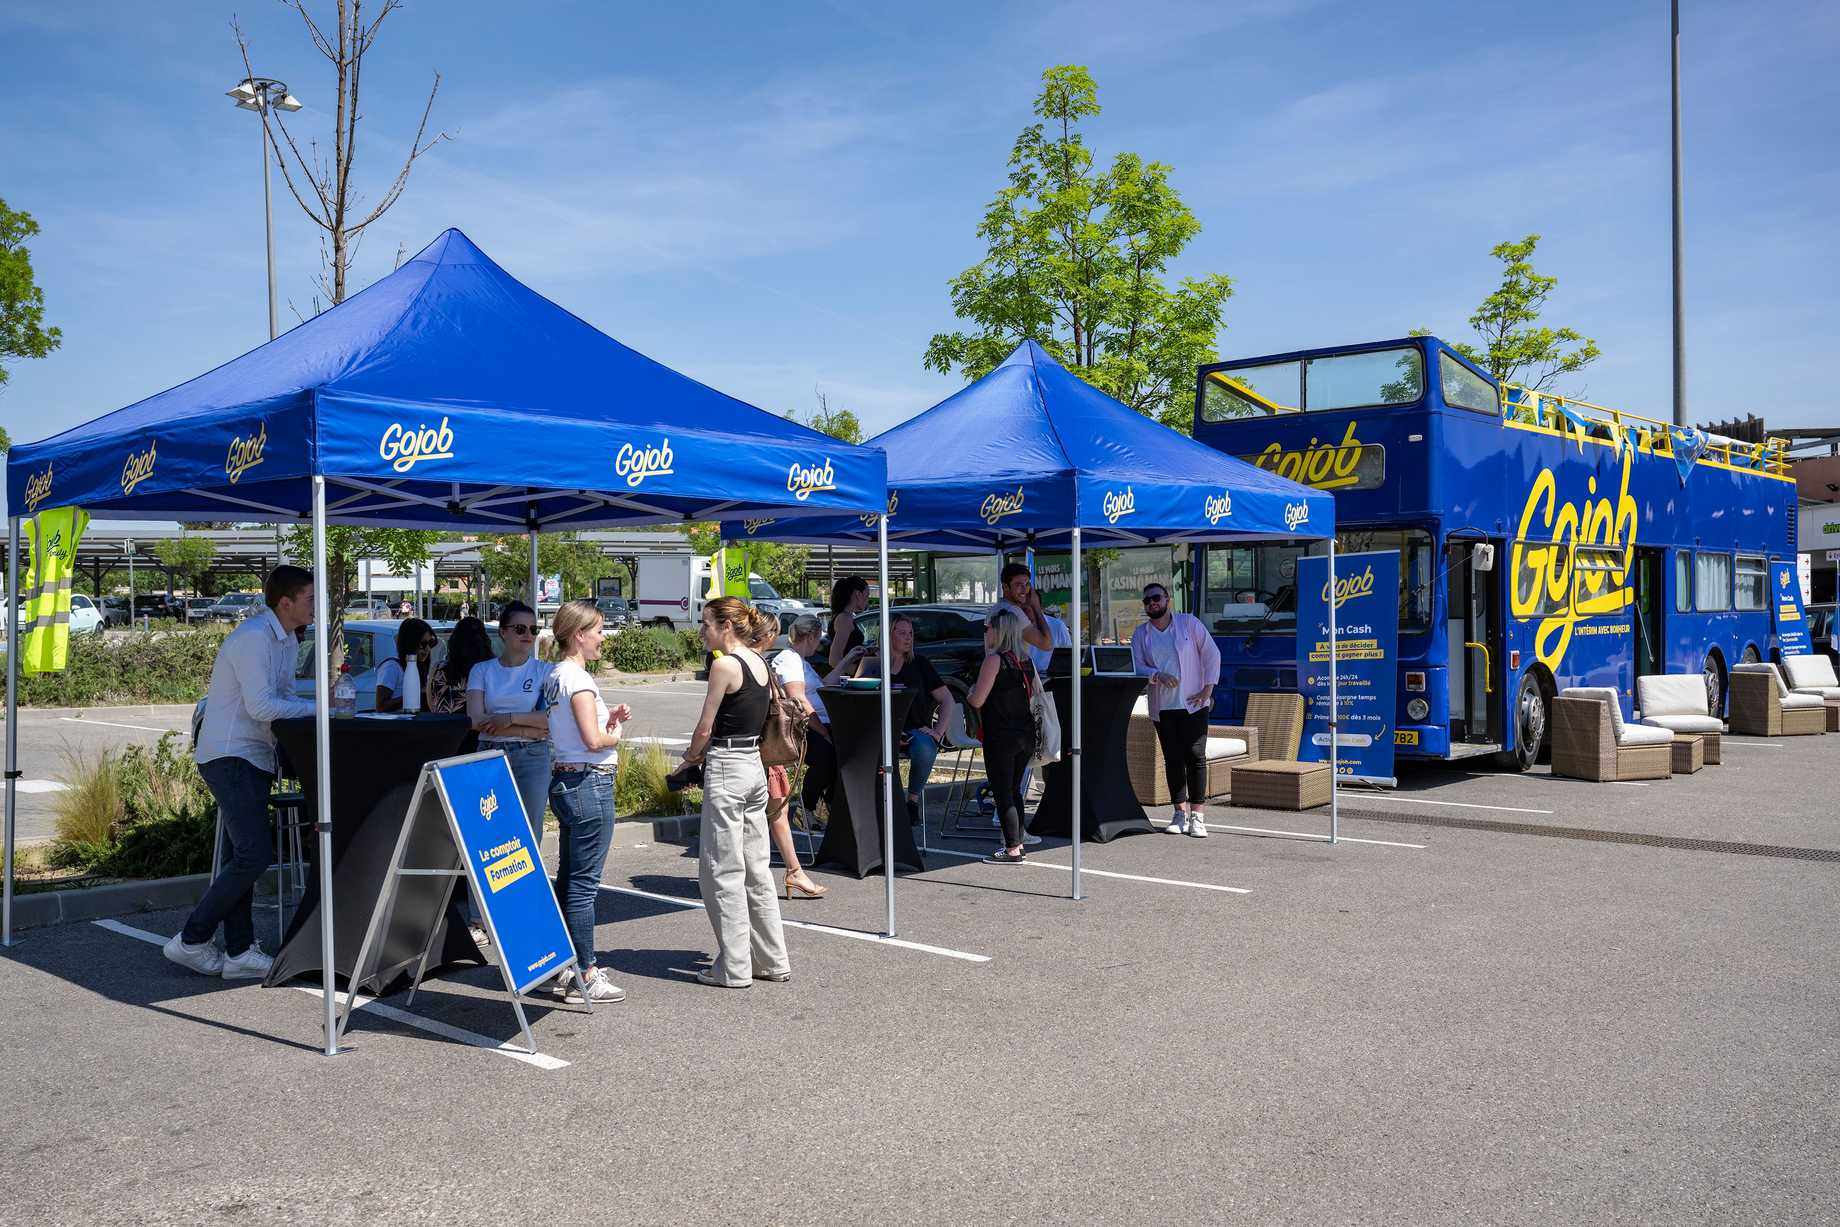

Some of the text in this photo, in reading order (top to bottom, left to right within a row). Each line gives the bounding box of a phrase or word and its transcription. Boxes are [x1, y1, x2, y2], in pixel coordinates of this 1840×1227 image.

[226, 421, 267, 484] Gojob
[379, 416, 454, 473] Gojob
[1255, 420, 1362, 489] Gojob
[121, 439, 157, 496] Gojob
[615, 437, 674, 487] Gojob
[787, 457, 837, 501] Gojob
[25, 461, 53, 513] Gojob
[979, 486, 1024, 525] Gojob
[1103, 486, 1136, 525] Gojob
[1204, 490, 1233, 526] Gojob
[1285, 498, 1310, 531] Gojob
[1824, 522, 1840, 534] driv
[1511, 449, 1638, 673] Gojob
[1322, 565, 1375, 609] Gojob
[1322, 624, 1372, 636] Mn Cash
[1349, 639, 1373, 649] décider
[1598, 625, 1610, 635] AVEC
[1364, 649, 1378, 659] plus
[523, 678, 534, 692] G
[1358, 694, 1377, 702] temps
[1395, 732, 1414, 744] 782
[480, 788, 499, 820] Gojob
[478, 836, 521, 862] Le comptoir
[490, 859, 528, 881] Formation
